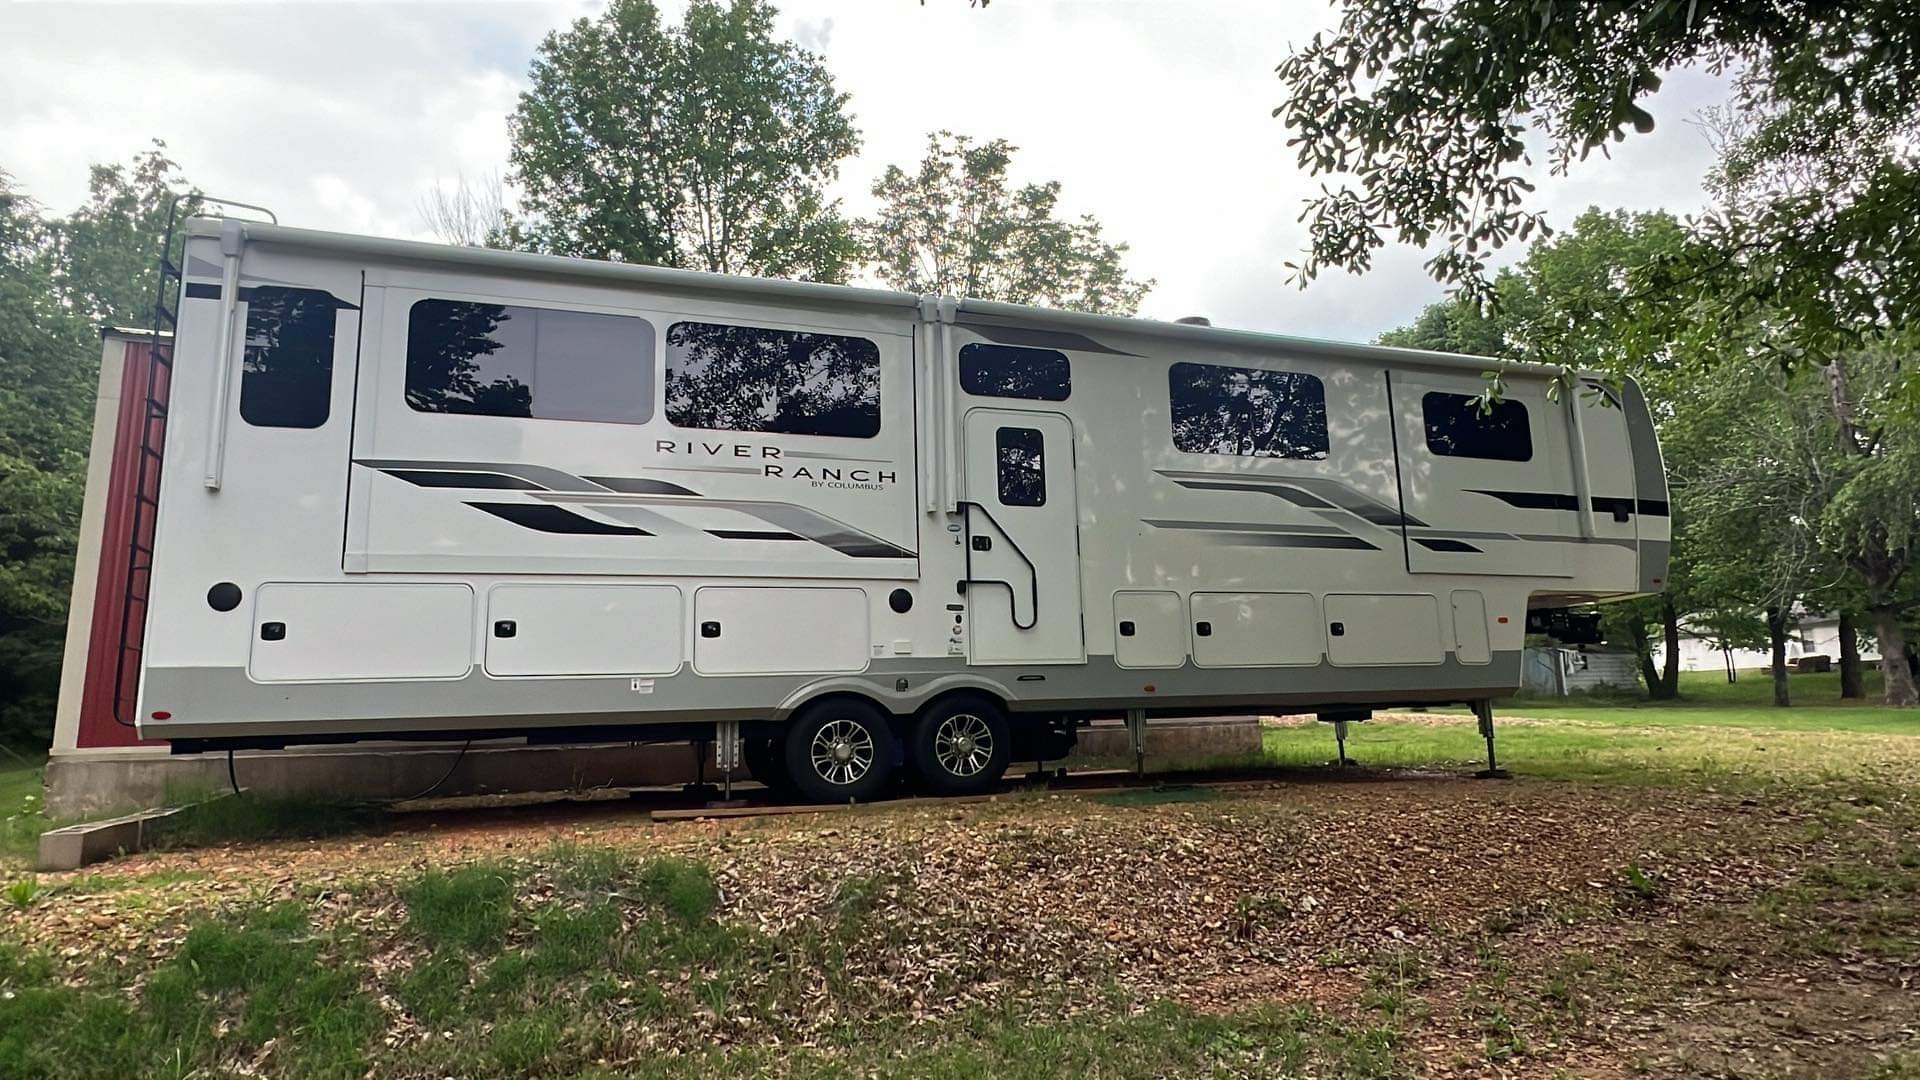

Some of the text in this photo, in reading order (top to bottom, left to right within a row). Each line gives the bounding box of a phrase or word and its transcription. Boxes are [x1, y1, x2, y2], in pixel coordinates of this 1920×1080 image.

[656, 440, 781, 459] RIVER
[764, 464, 896, 483] RANCH
[811, 480, 884, 491] BY COLUMBUS
